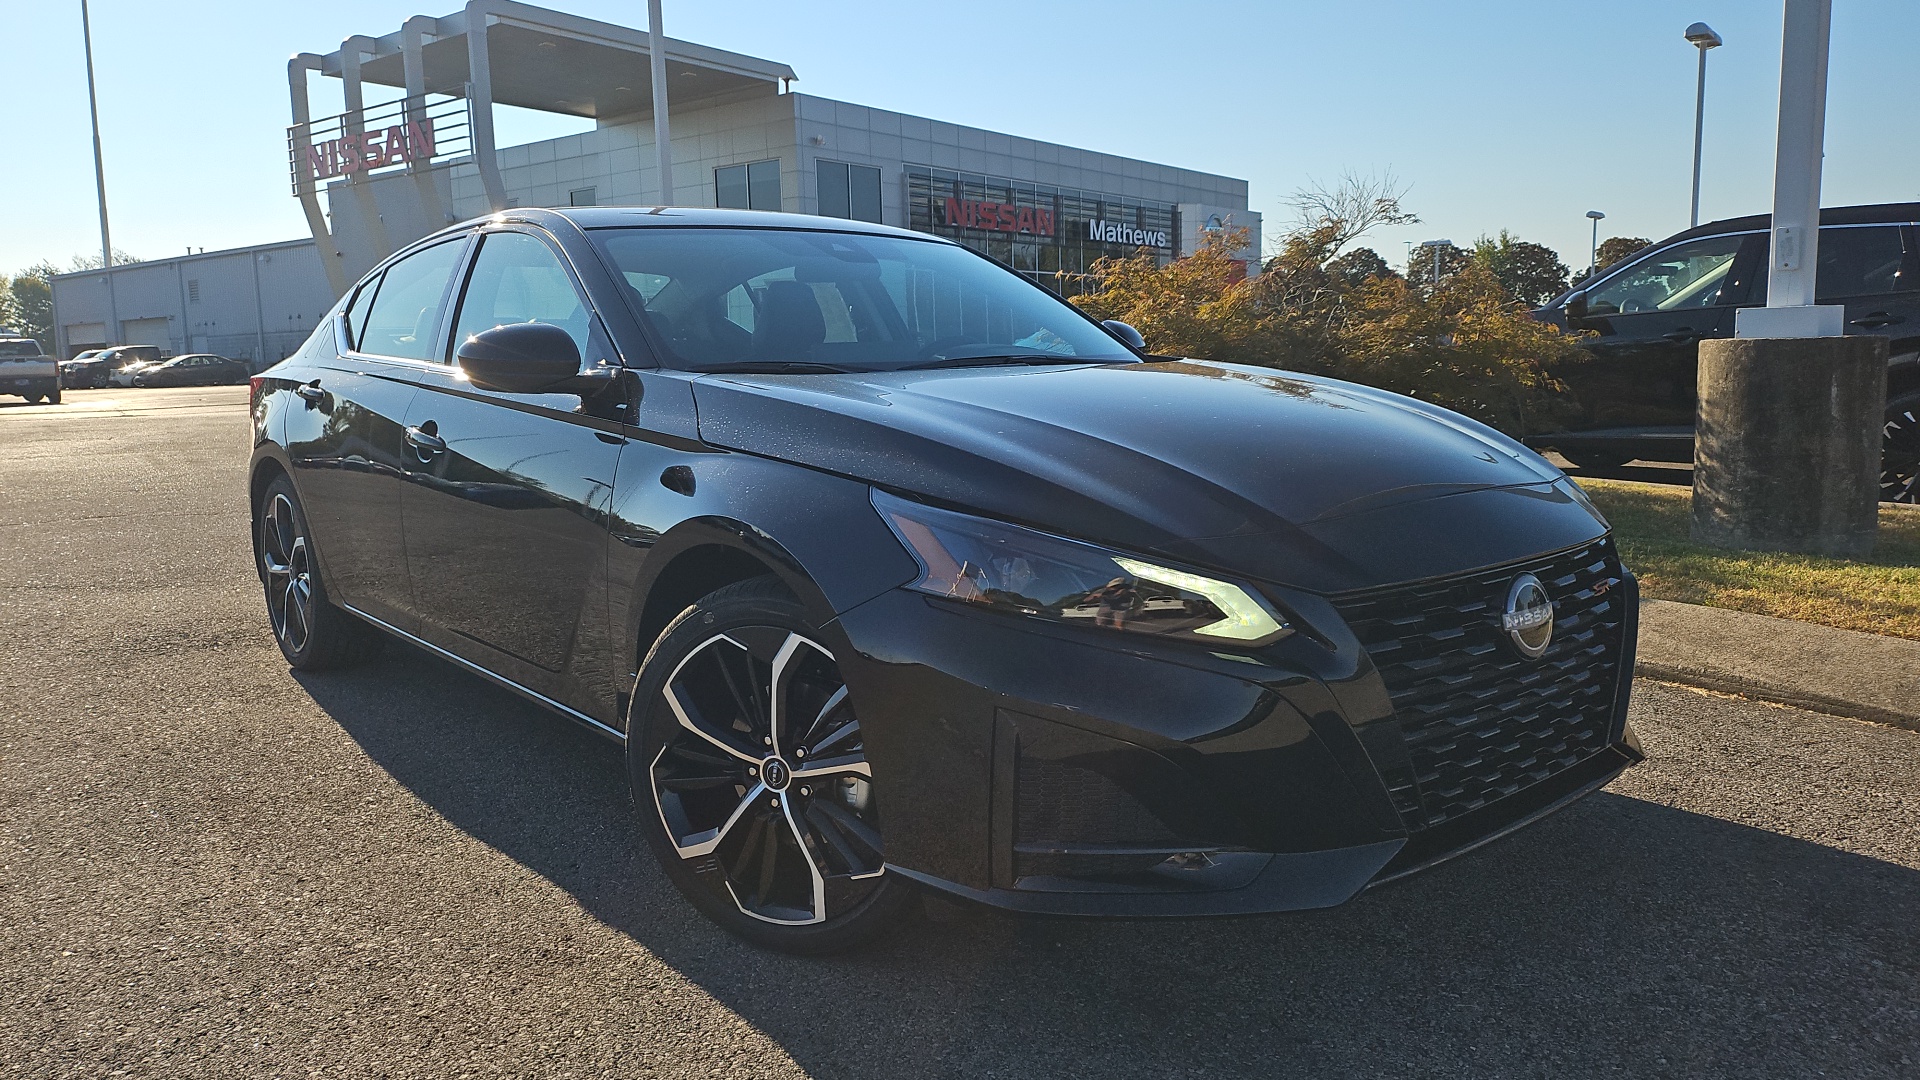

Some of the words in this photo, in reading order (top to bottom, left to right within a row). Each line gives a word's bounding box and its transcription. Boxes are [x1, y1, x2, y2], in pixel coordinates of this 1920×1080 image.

[304, 118, 436, 181] NISSAN
[946, 196, 1055, 236] NISSAN
[1089, 218, 1166, 247] Mathews
